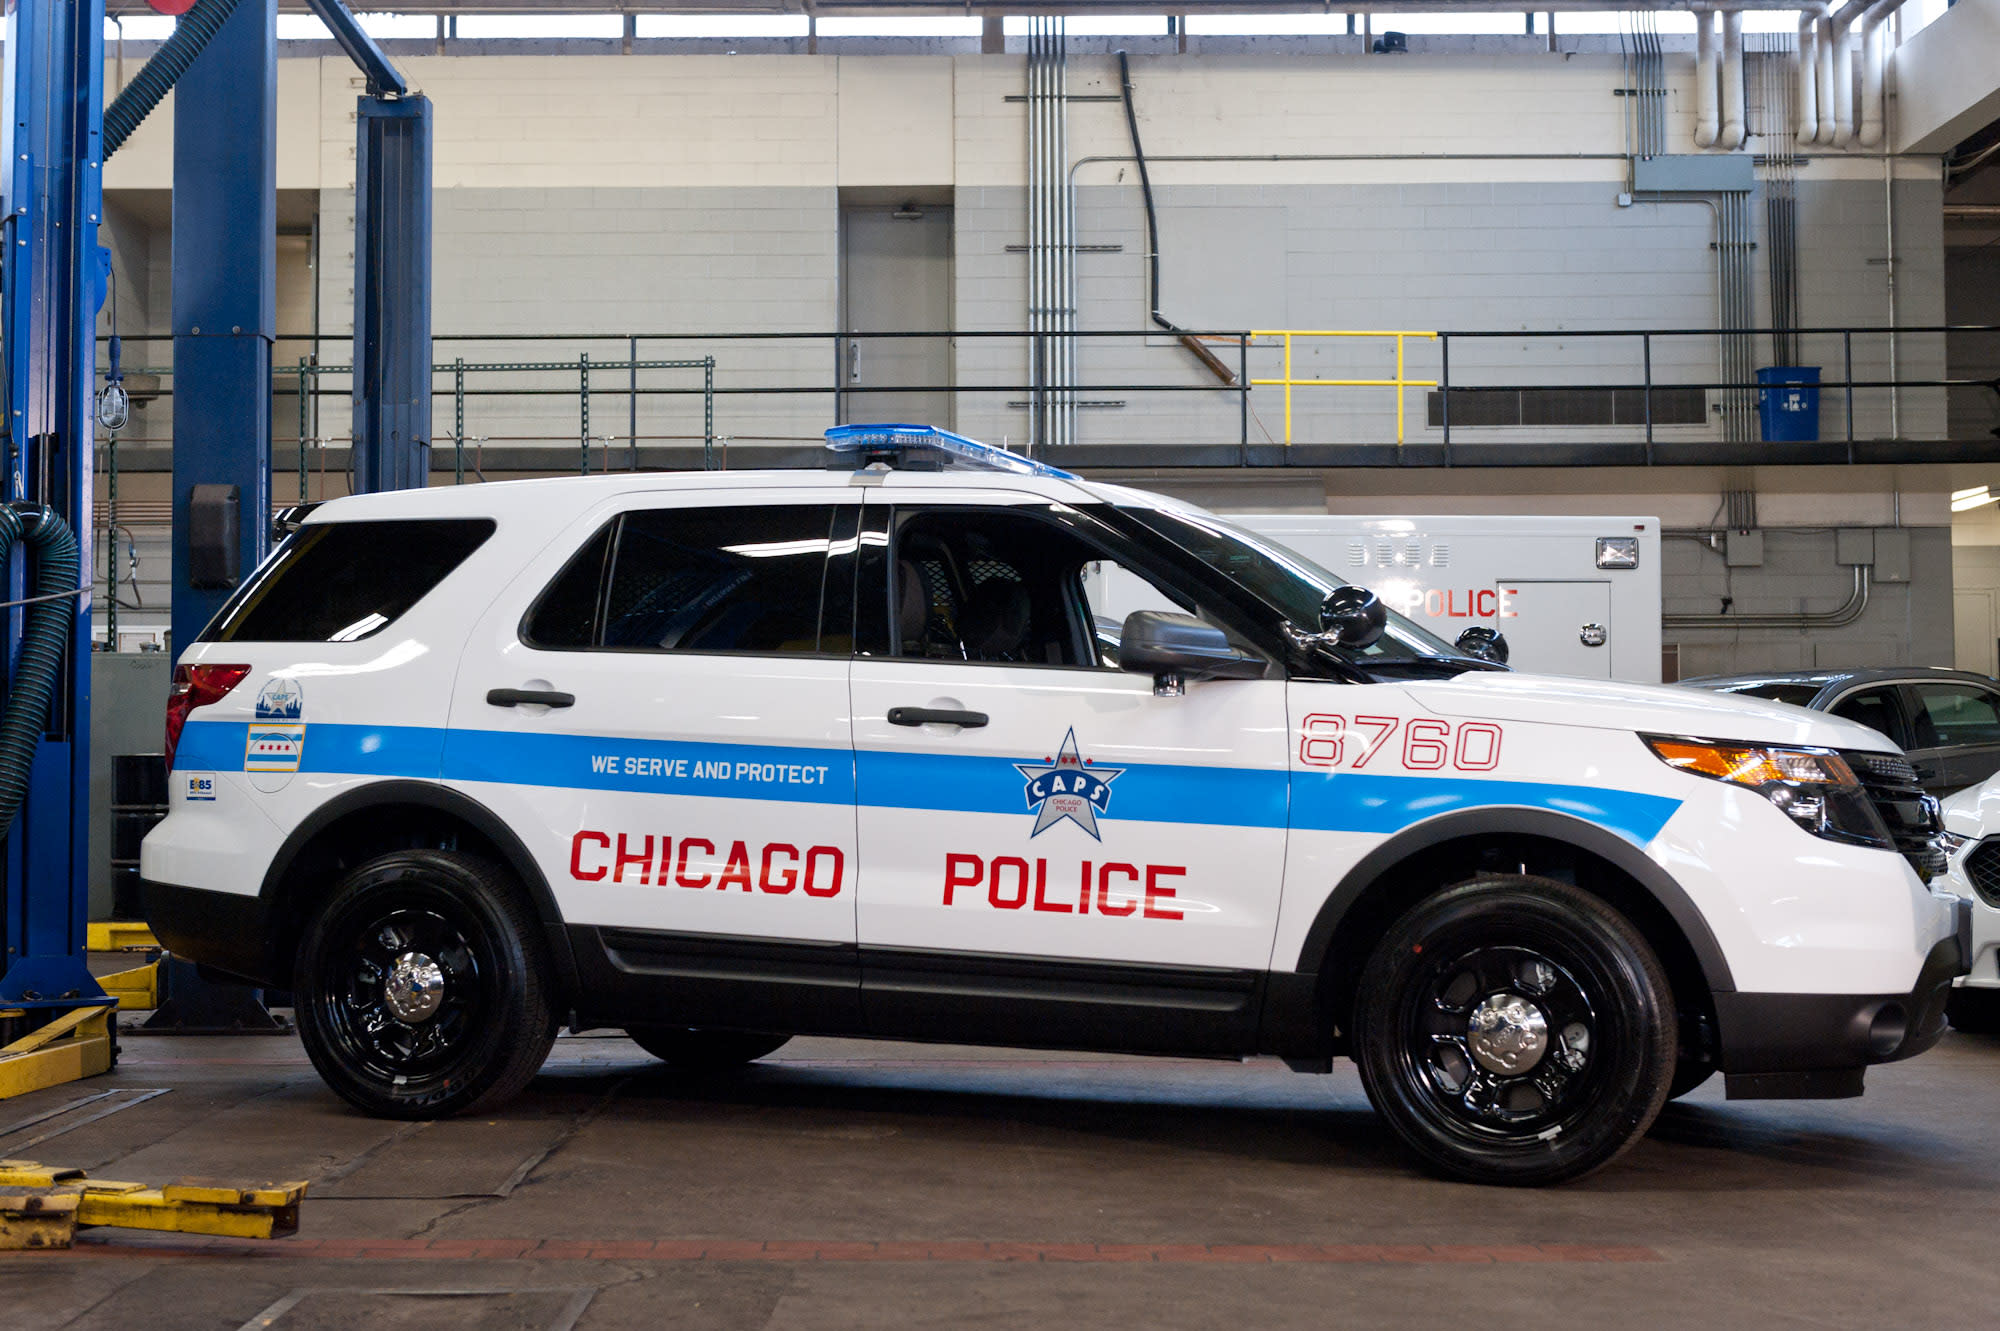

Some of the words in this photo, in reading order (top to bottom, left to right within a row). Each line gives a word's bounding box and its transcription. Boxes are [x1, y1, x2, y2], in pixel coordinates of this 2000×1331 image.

[1404, 588, 1519, 618] POLICE
[1299, 712, 1503, 771] 8760
[591, 755, 619, 774] WE
[624, 757, 689, 778] SERVE
[692, 760, 732, 780] AND
[735, 762, 829, 785] PROTECT
[1032, 775, 1105, 801] CAPS
[1052, 798, 1082, 806] CHICAGO
[1055, 805, 1078, 813] POLICE
[570, 830, 844, 898] CHICAGO
[943, 853, 1187, 921] POLICE
